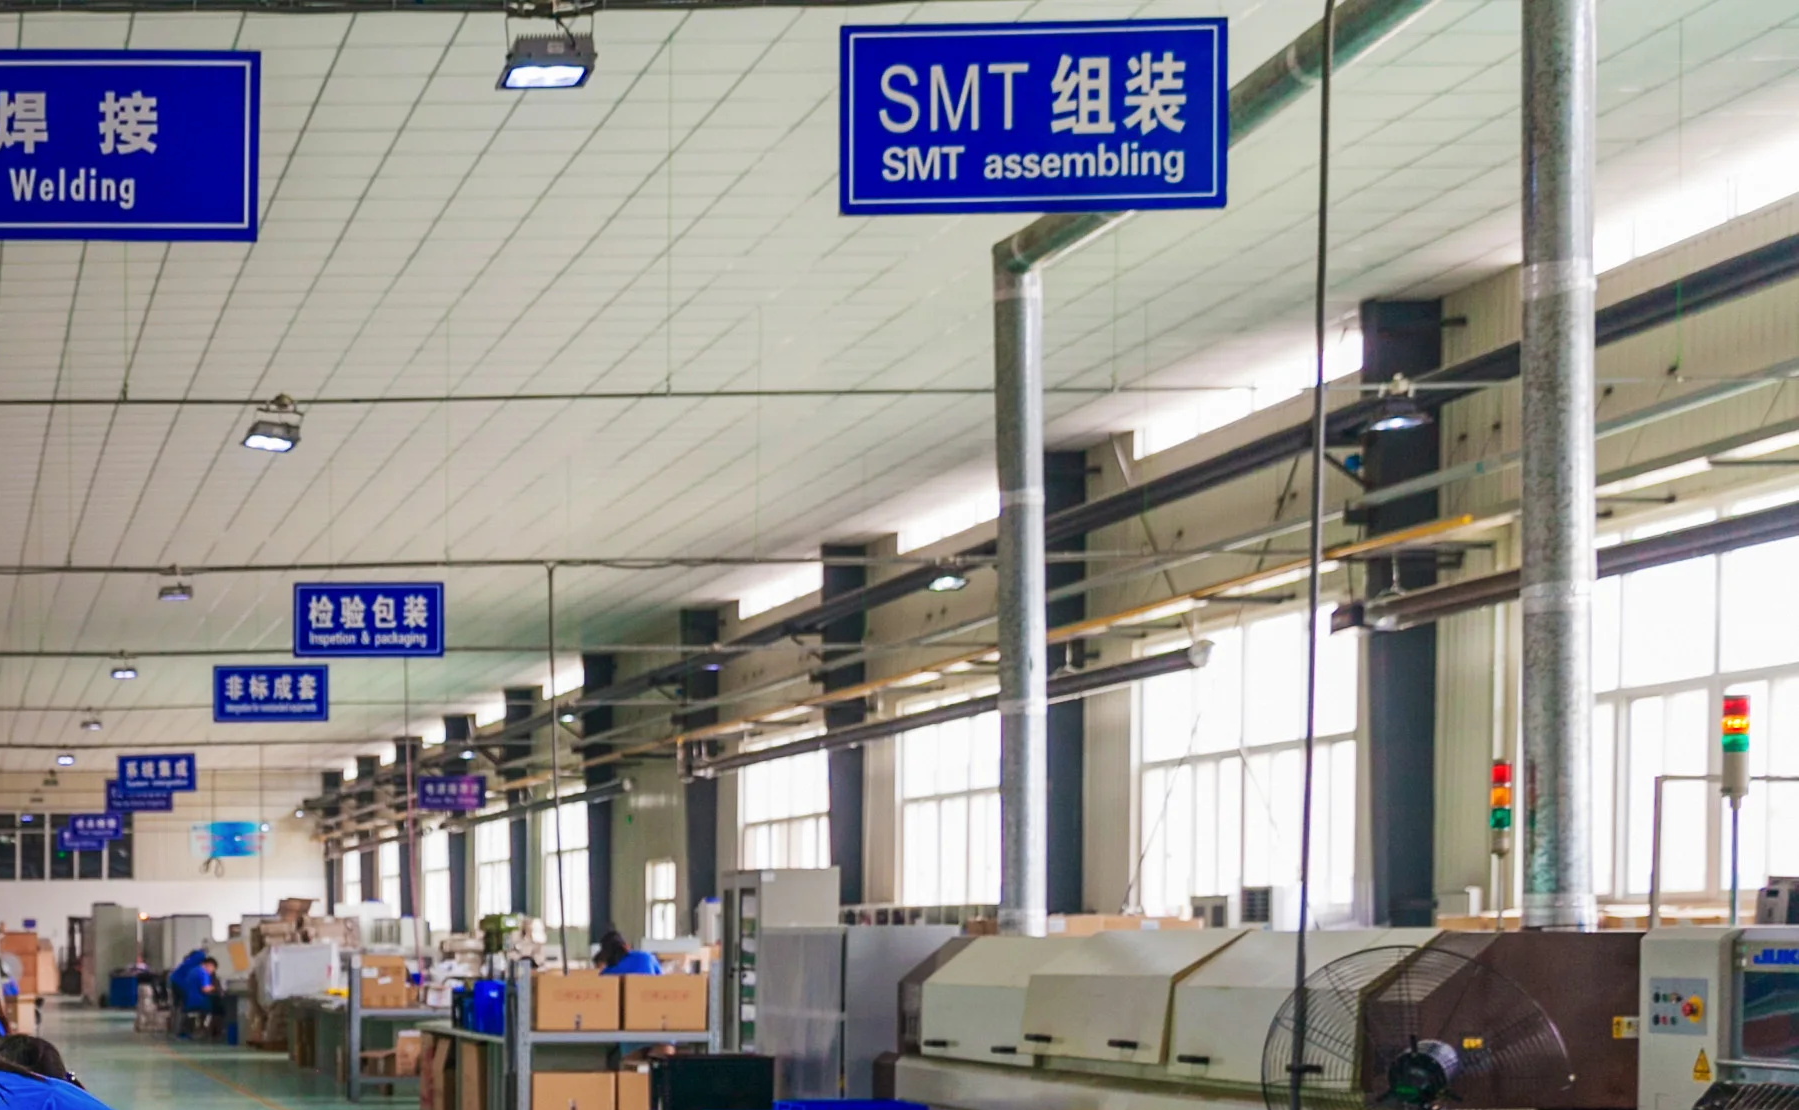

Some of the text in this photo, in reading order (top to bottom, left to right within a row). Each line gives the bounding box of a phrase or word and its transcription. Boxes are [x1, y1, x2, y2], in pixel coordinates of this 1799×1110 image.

[878, 52, 1187, 136] SMT 组装
[881, 142, 1185, 184] SMT assembling
[9, 167, 136, 210] Welding
[308, 594, 428, 629] 检验包装
